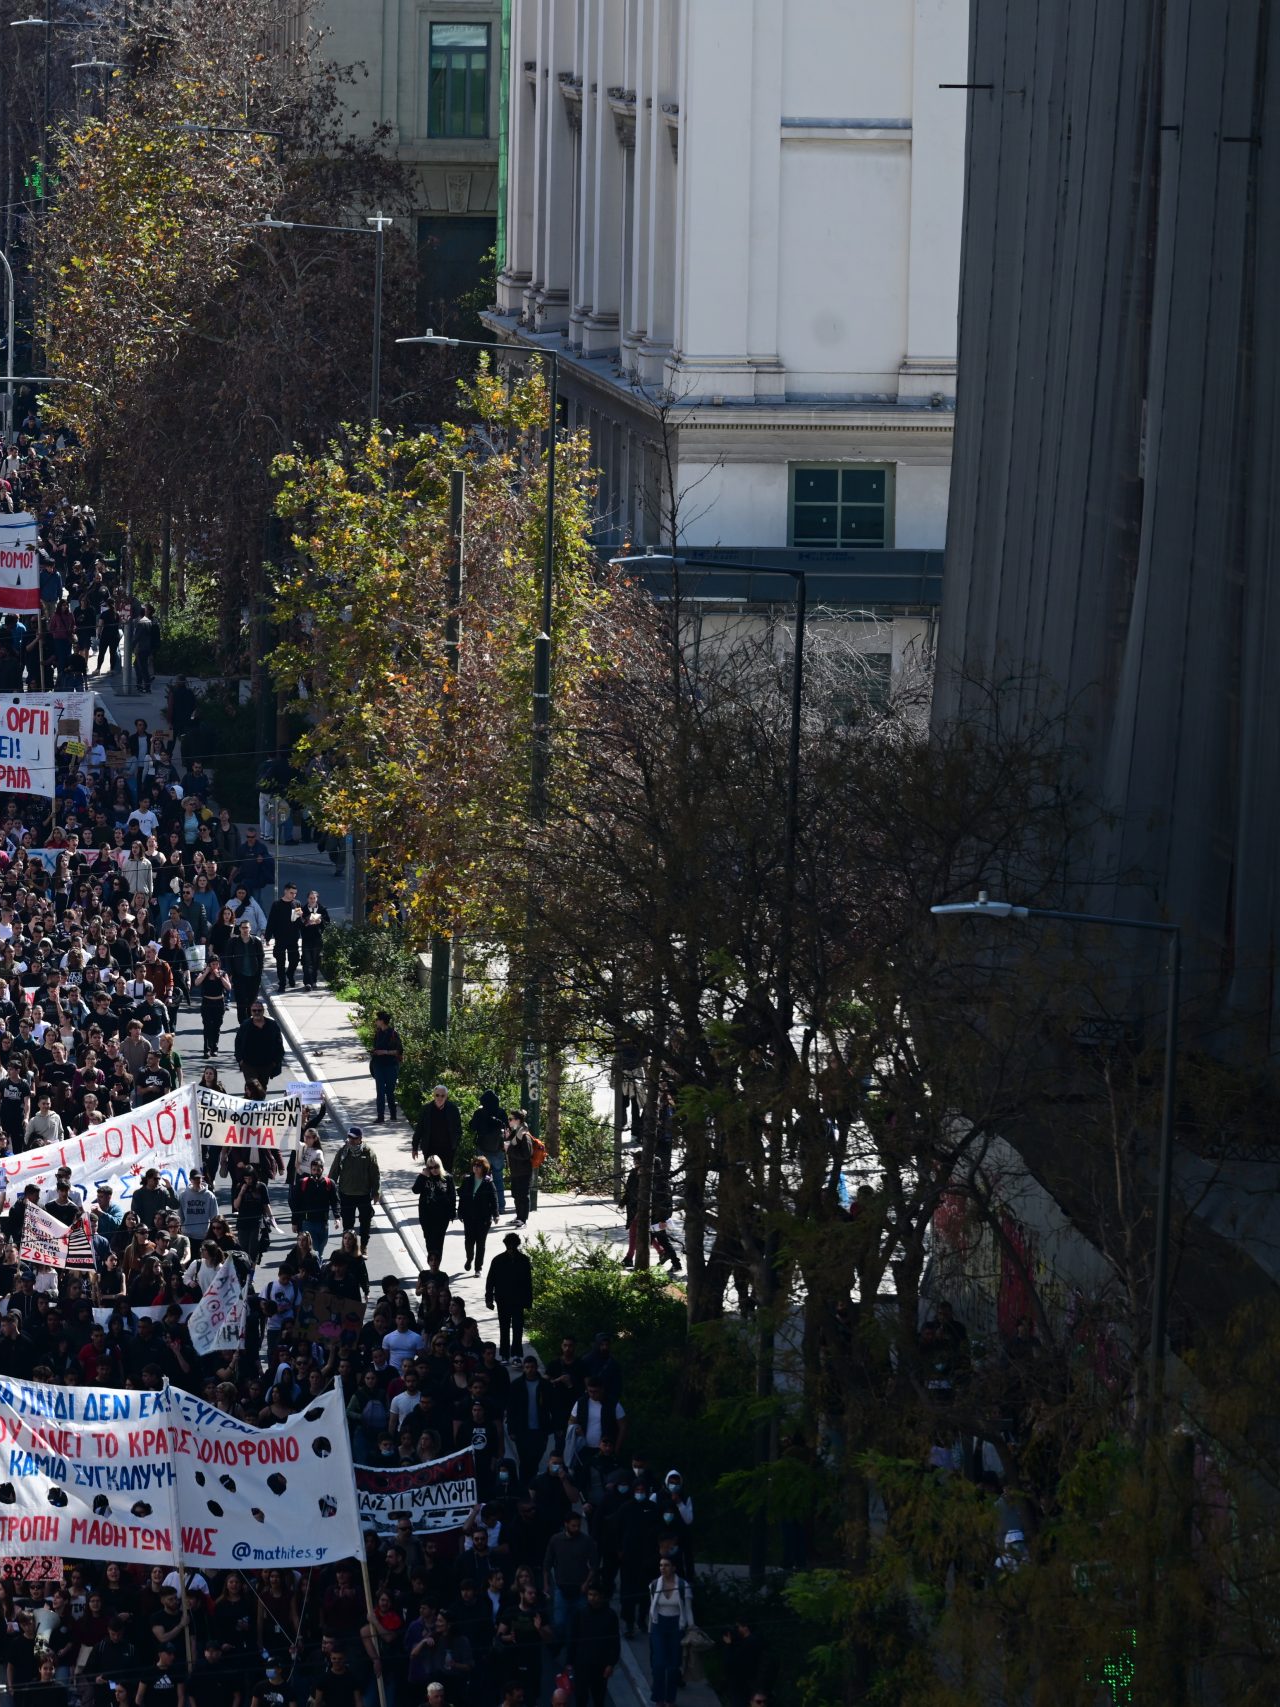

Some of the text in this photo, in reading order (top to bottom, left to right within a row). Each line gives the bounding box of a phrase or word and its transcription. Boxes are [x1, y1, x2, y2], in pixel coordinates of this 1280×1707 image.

[6, 706, 50, 736] ΟΡΓΗ
[200, 1107, 299, 1128] ΤΩΝ ΦΟΙΤΗΤΩΝ
[243, 1097, 302, 1113] ΒΑΜΜΕΝΑ
[200, 1122, 275, 1147] ΤΟ ΑΙΜΑ
[20, 1386, 75, 1421] ΠΑΙΔΙ
[83, 1393, 131, 1422] ΔΕΝ
[92, 1432, 119, 1458] ΤΟ
[10, 1450, 177, 1492] ΚΑΜΙΑ ΣΥΓΚΑΛΥΨΗ
[375, 1480, 476, 1511] ΣΥΓΚΑΛΥΨΗ
[70, 1517, 172, 1552] ΜΑΘΗΤΩΝ
[231, 1541, 329, 1562] @mathites.gr
